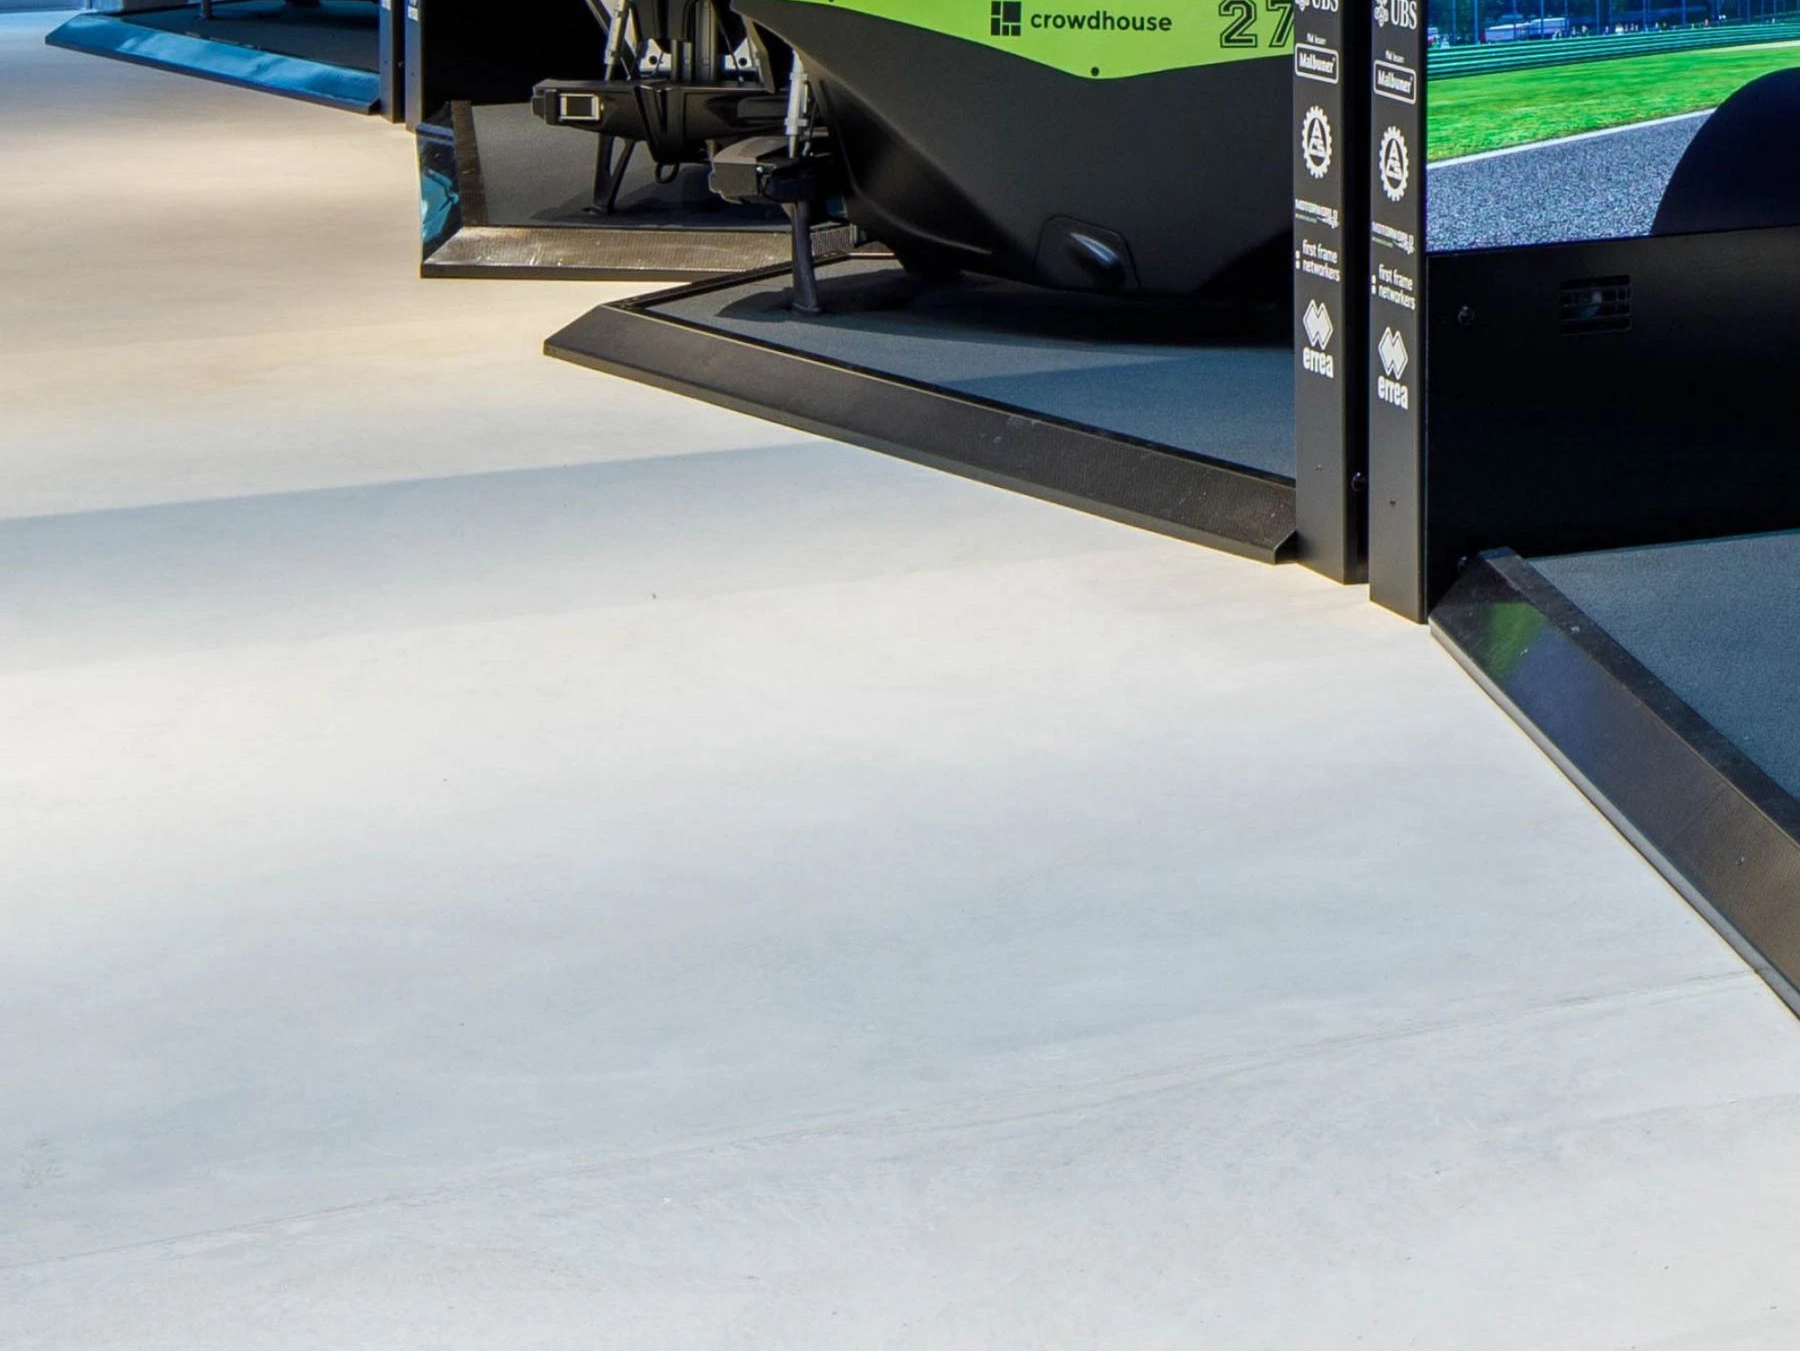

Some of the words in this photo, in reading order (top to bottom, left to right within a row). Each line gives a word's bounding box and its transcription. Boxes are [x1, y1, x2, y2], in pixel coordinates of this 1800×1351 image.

[1030, 9, 1173, 34] crowdhouse
[1302, 239, 1316, 258] first
[1317, 243, 1338, 264] frame
[1302, 259, 1340, 282] networkers
[1379, 263, 1393, 284] first
[1394, 269, 1413, 291] frame
[1379, 284, 1416, 310] networkers
[1303, 347, 1334, 378] errea
[1378, 375, 1409, 410] errea
